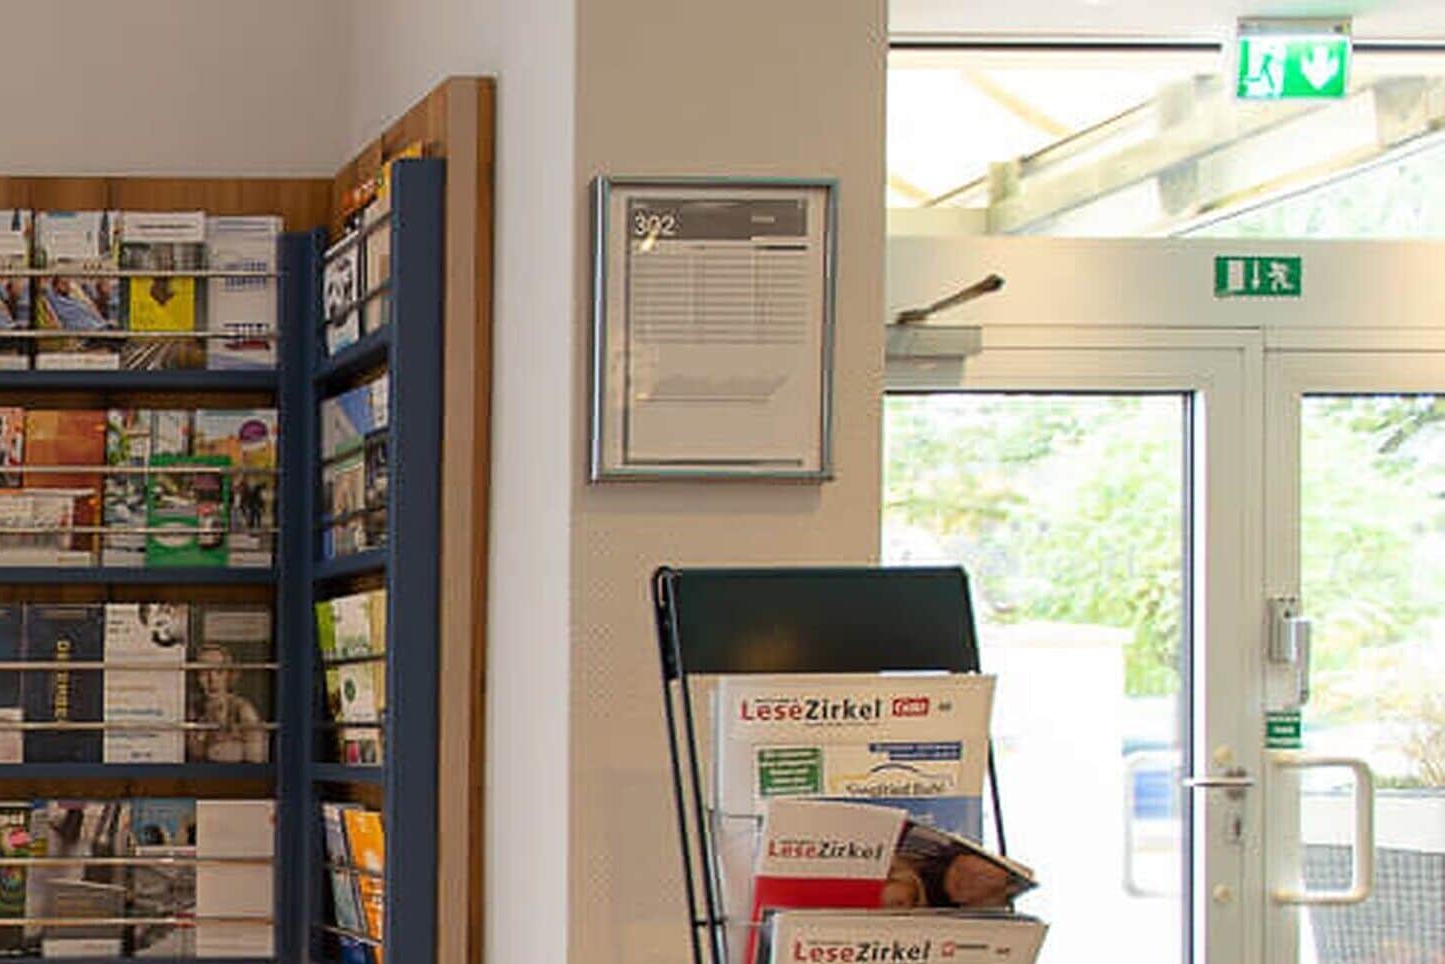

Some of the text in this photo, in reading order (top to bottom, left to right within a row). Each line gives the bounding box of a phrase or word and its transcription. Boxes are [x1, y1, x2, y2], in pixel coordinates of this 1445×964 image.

[740, 698, 881, 722] LeseZirkel
[767, 839, 884, 861] LeseZirkel
[793, 940, 932, 962] LeseZirkel
